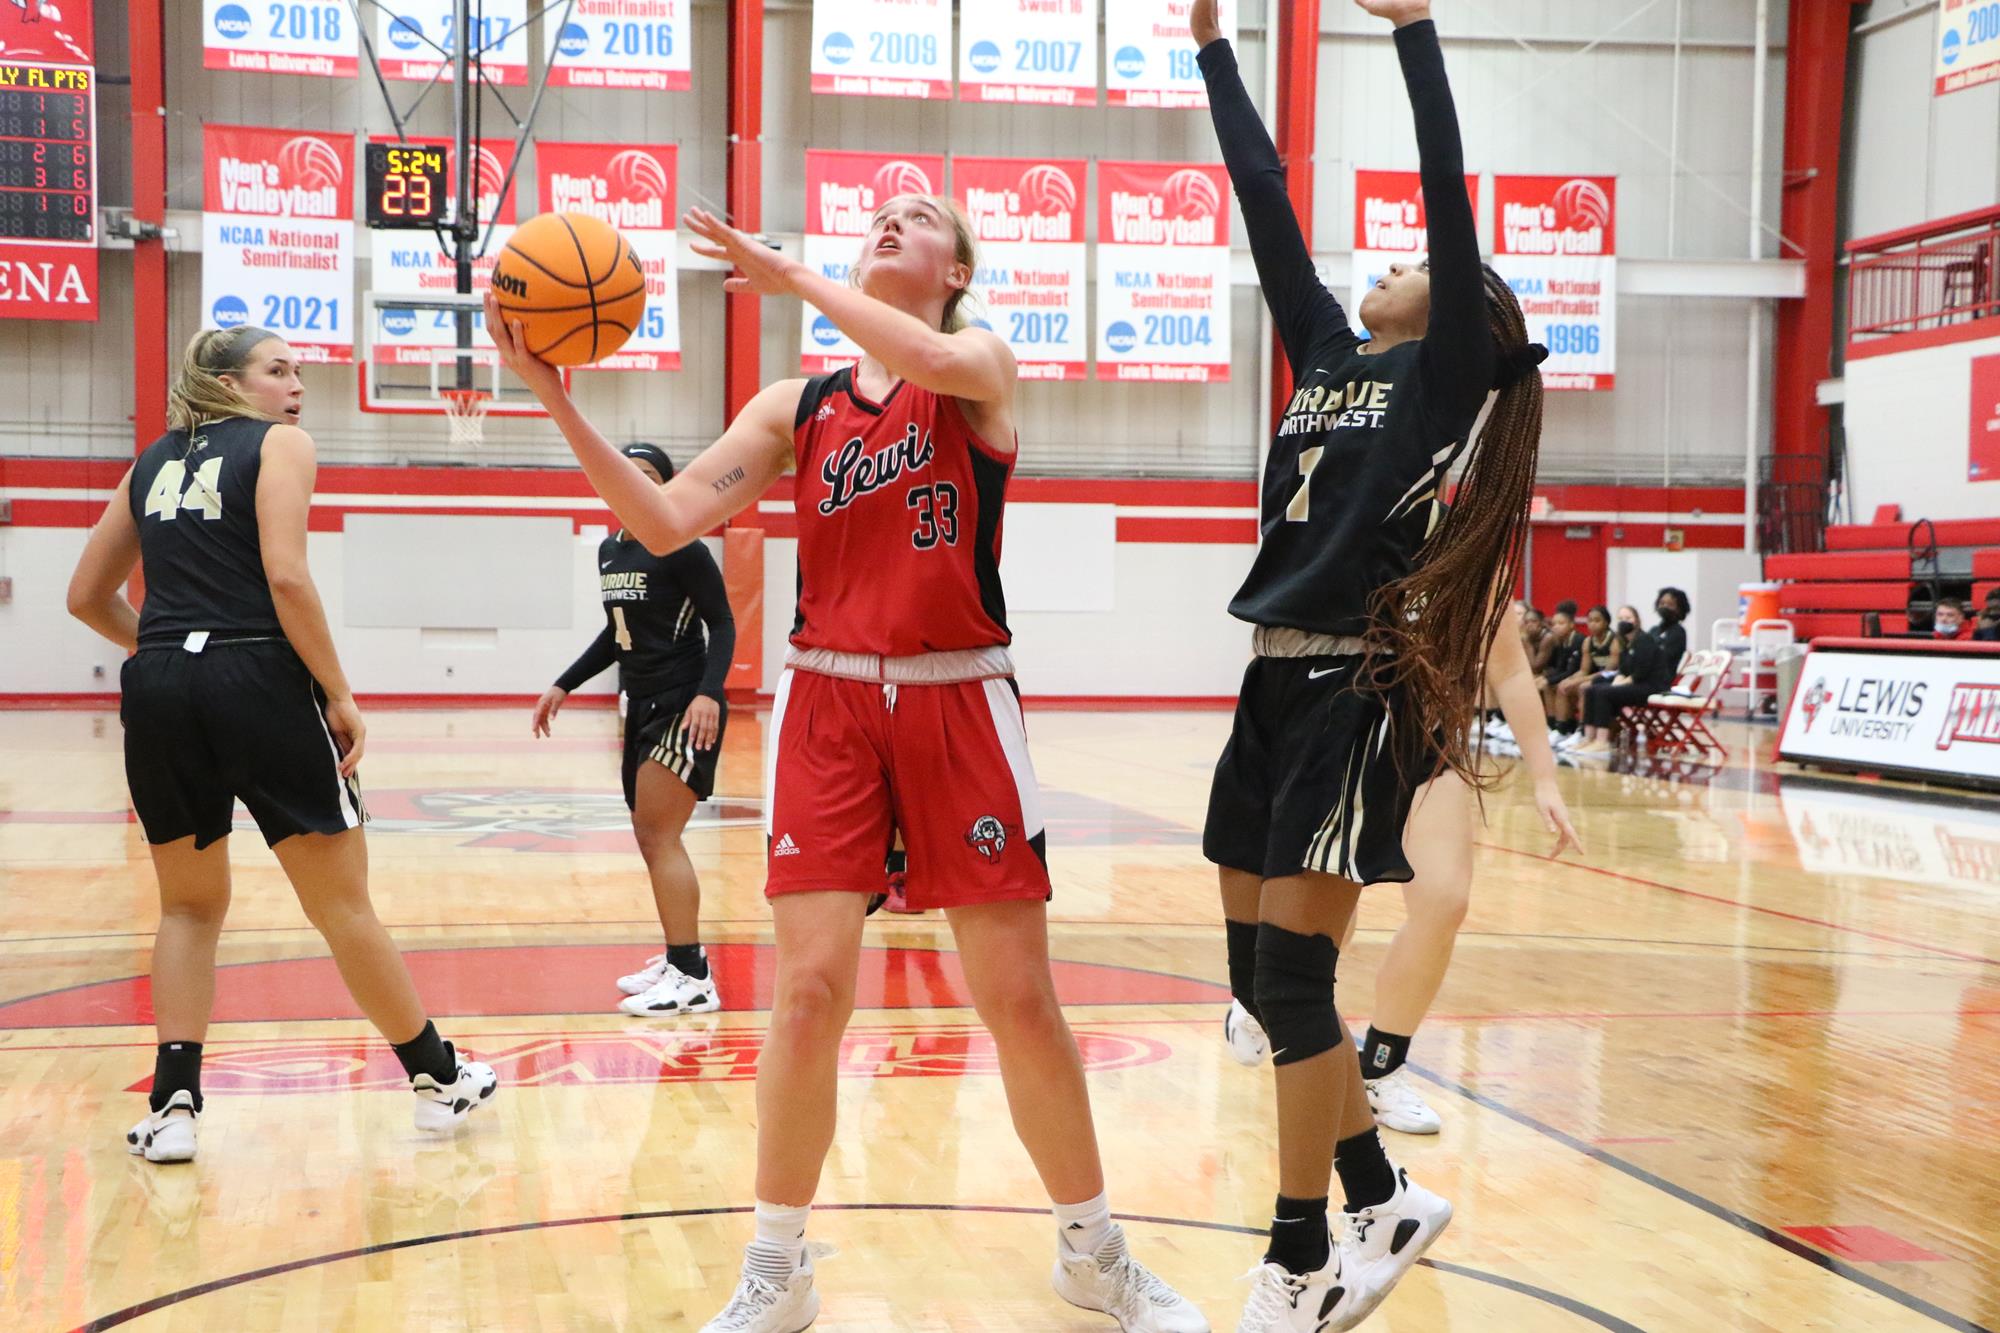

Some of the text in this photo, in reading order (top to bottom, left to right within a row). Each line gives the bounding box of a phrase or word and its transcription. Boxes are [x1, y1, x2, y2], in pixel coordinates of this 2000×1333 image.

[578, 0, 675, 18] Semifinalist
[269, 4, 340, 41] 2018
[603, 22, 673, 57] 2016
[869, 31, 937, 66] 2009
[229, 50, 334, 75] Lewis University
[1015, 39, 1082, 73] 2007
[28, 69, 49, 88] FL
[54, 71, 89, 91] PTS
[568, 67, 668, 90] Lewis University
[833, 75, 930, 99] Lewis University
[73, 95, 85, 115] 3
[981, 83, 1076, 106] Lewis University
[1126, 90, 1160, 107] Lewis
[33, 143, 87, 166] 2 6
[387, 150, 441, 175] 5:24
[35, 167, 87, 190] 3 6
[220, 157, 280, 186] Men's
[382, 174, 431, 216] 23
[551, 173, 608, 200] Men's
[820, 182, 875, 209] Men's
[74, 195, 88, 216] 0
[220, 182, 338, 218] Volleyball
[966, 187, 1020, 213] Men's
[1110, 191, 1164, 218] Men's
[1364, 197, 1418, 225] Men's
[971, 210, 1071, 243] Volleyball
[1503, 202, 1556, 229] Men's
[220, 226, 340, 250] NCAA National
[1111, 215, 1215, 246] Volleyball
[1364, 221, 1428, 252] Volley
[1503, 226, 1603, 256] Volleyball
[242, 249, 340, 271] Semifinalist
[391, 250, 432, 268] NCAA
[822, 263, 849, 281] NCA
[972, 269, 1070, 287] NCAA National
[1115, 271, 1213, 289] NCAA National
[1507, 278, 1601, 297] NCAA National
[987, 290, 1069, 308] Semifinalist
[1131, 291, 1213, 310] Semifinalist
[1522, 299, 1600, 316] Semifinalist
[214, 295, 339, 331] NCAA 2021
[1009, 312, 1069, 344] 2012
[1144, 314, 1213, 346] 2004
[1545, 323, 1600, 355] 1996
[1117, 364, 1209, 383] Lewis University
[145, 456, 224, 522] 44
[711, 465, 745, 497] XXXIII
[1285, 445, 1325, 522] 1
[907, 480, 960, 551] 33
[1837, 677, 1929, 718] LEWIS
[1830, 717, 1915, 743] UNIVERSITY
[774, 847, 801, 858] adidas
